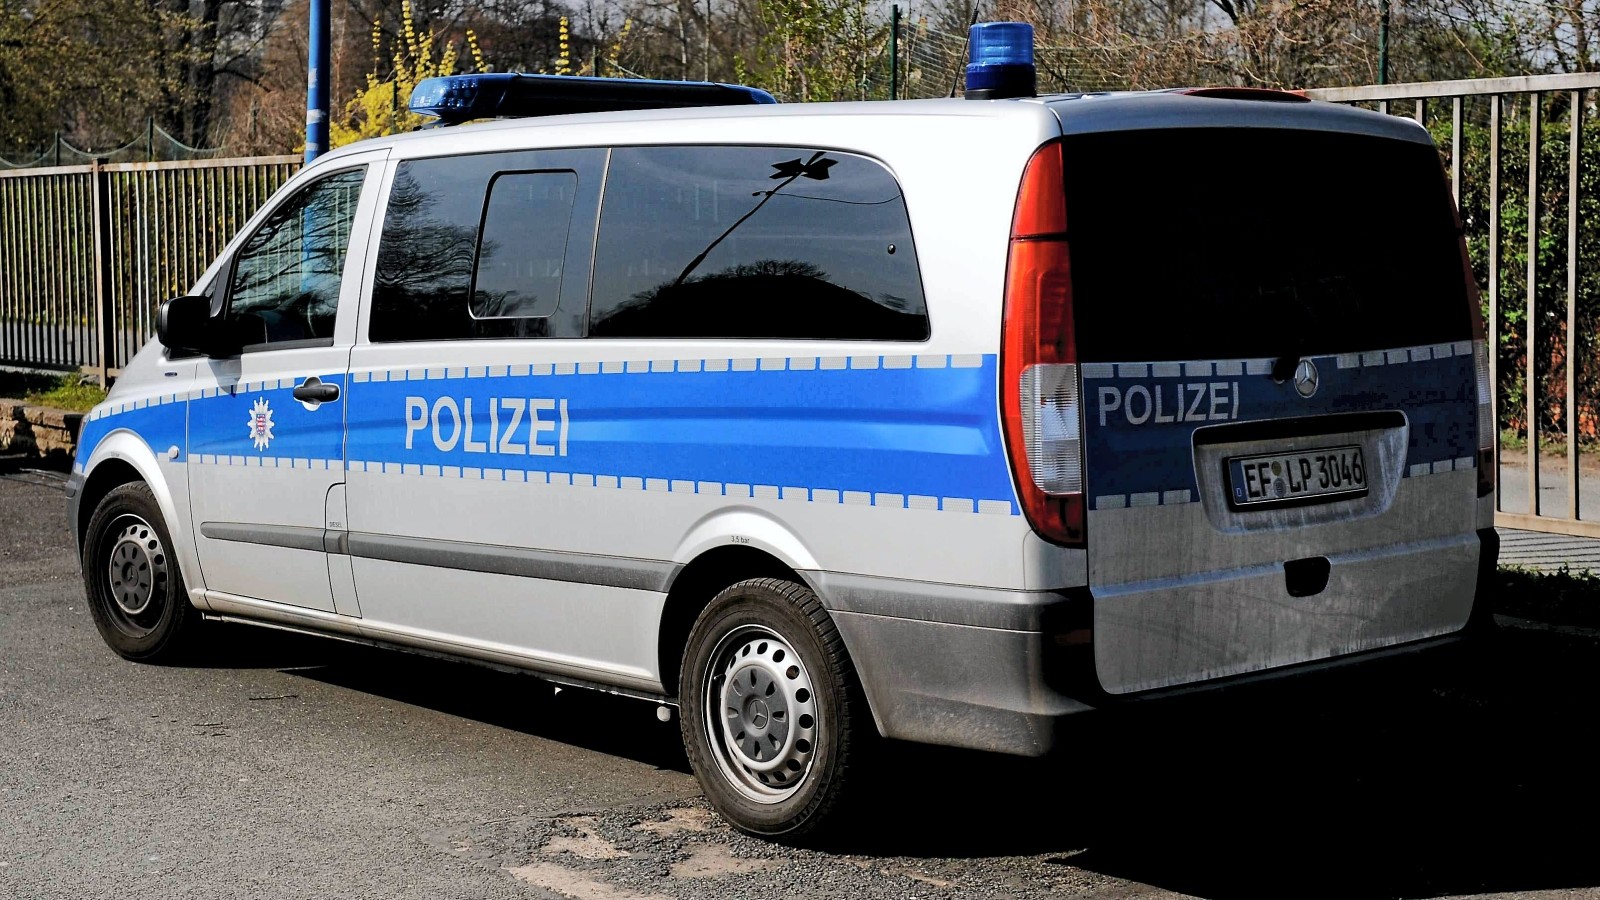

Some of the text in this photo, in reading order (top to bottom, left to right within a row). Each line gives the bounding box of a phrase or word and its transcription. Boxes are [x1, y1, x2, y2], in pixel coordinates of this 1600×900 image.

[405, 395, 569, 457] POLIZEI
[1098, 381, 1239, 427] POLIZEI
[1244, 452, 1363, 498] EF LP 3046
